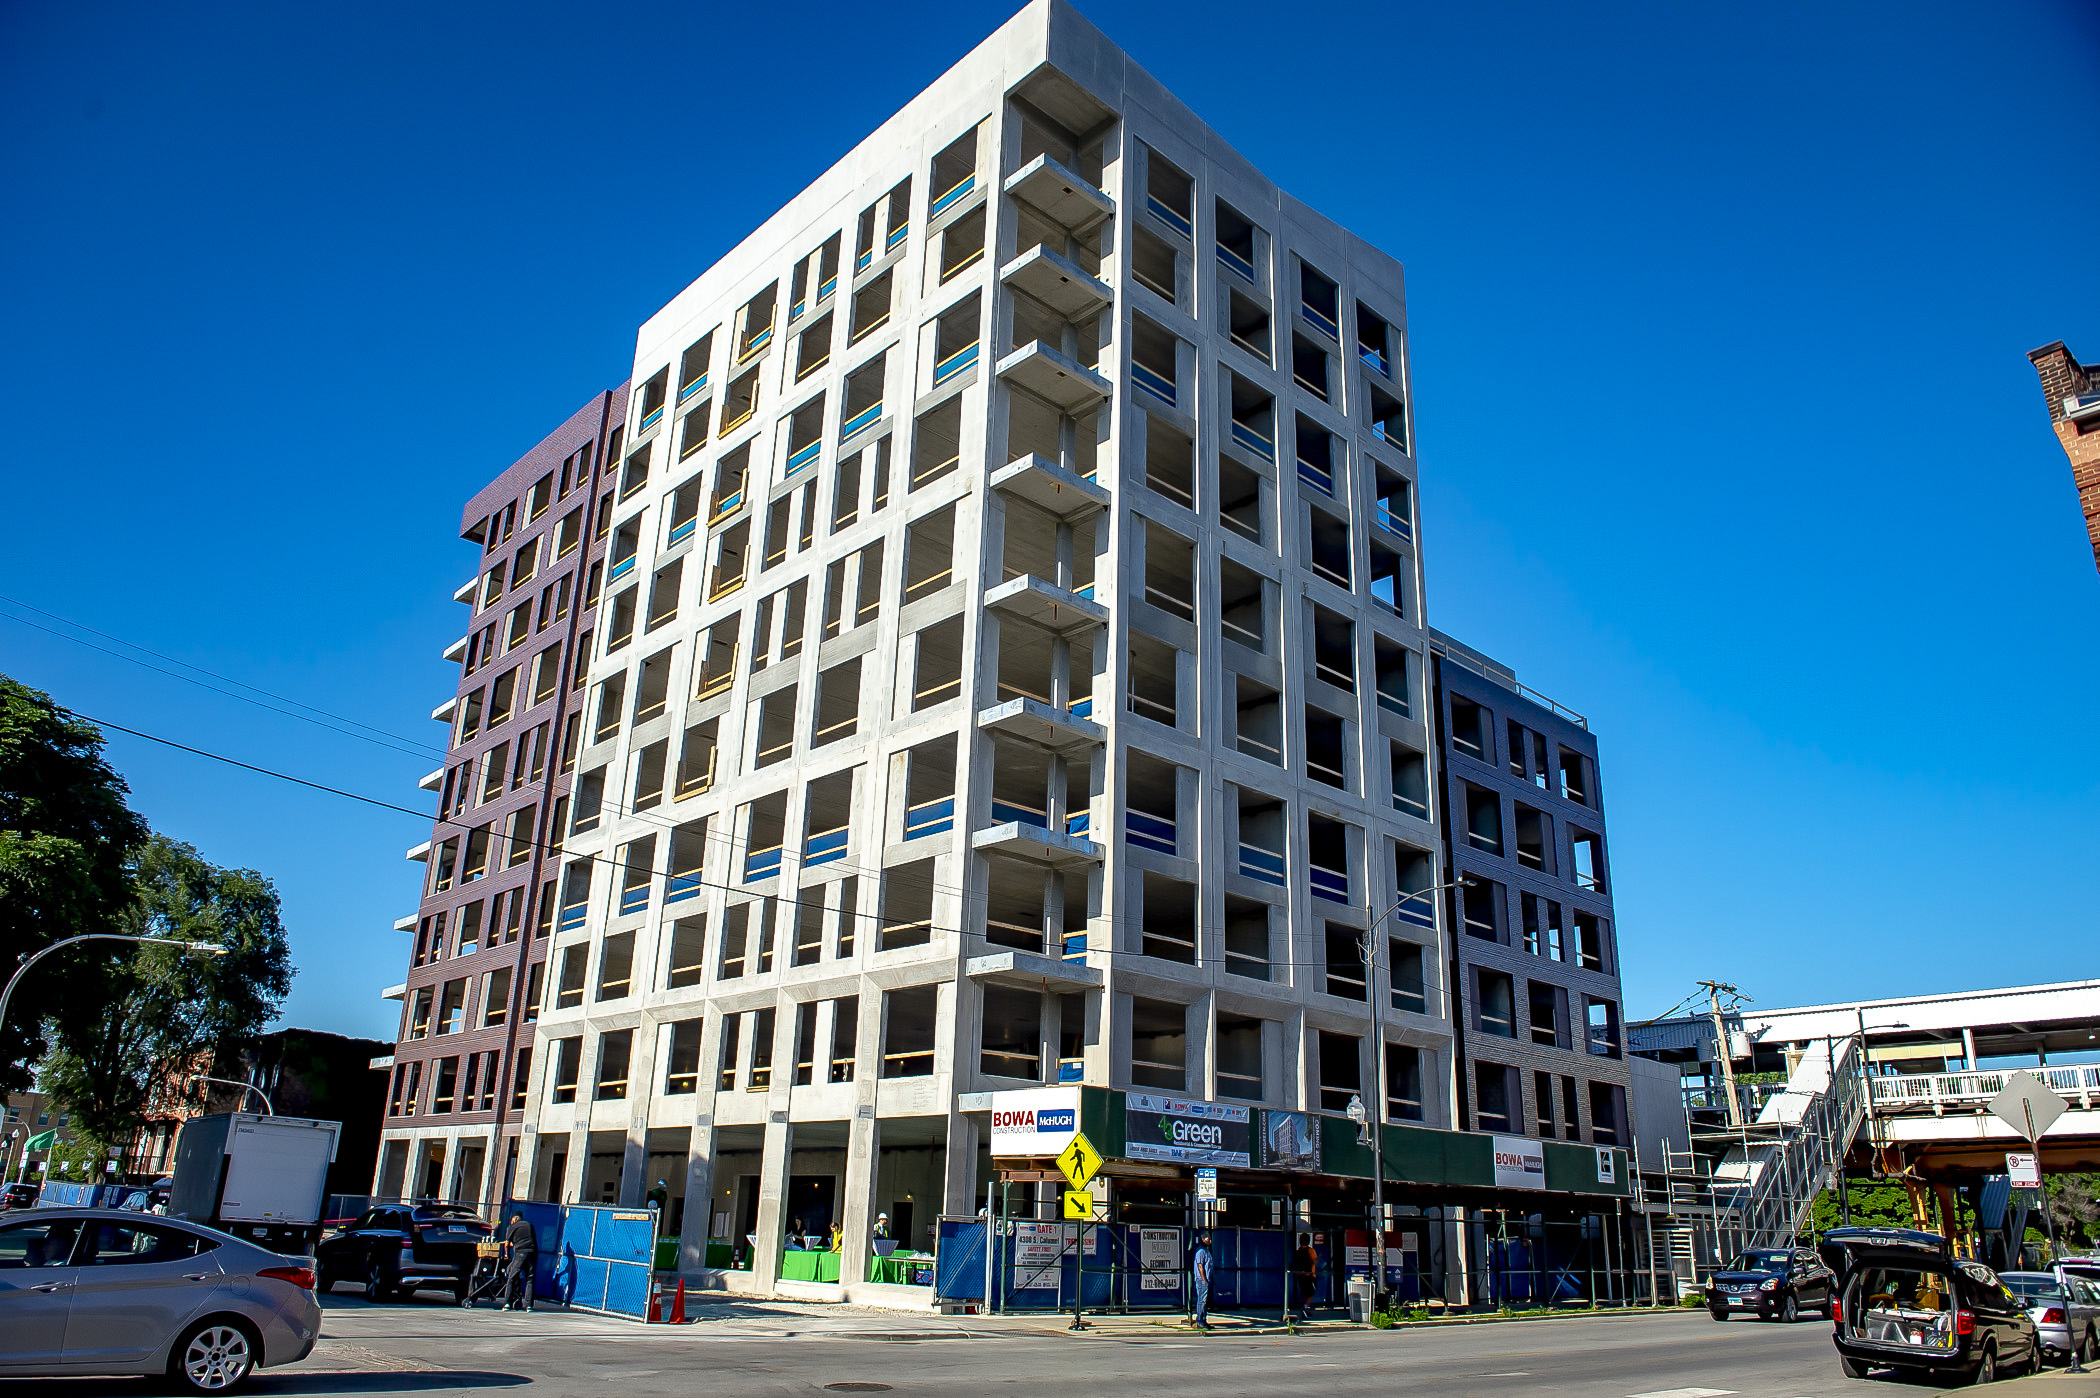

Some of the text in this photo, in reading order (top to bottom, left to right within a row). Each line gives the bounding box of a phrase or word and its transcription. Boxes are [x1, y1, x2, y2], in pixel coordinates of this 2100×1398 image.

[993, 1111, 1073, 1127] BOWA McHUGH
[993, 1126, 1036, 1135] CONSTRUCTION
[1495, 1152, 1523, 1166] BOWA
[1037, 1224, 1052, 1234] GATE
[1054, 1225, 1057, 1234] 1
[1143, 1230, 1177, 1241] CONSTRUCTION
[1149, 1259, 1171, 1268] SECURITY
